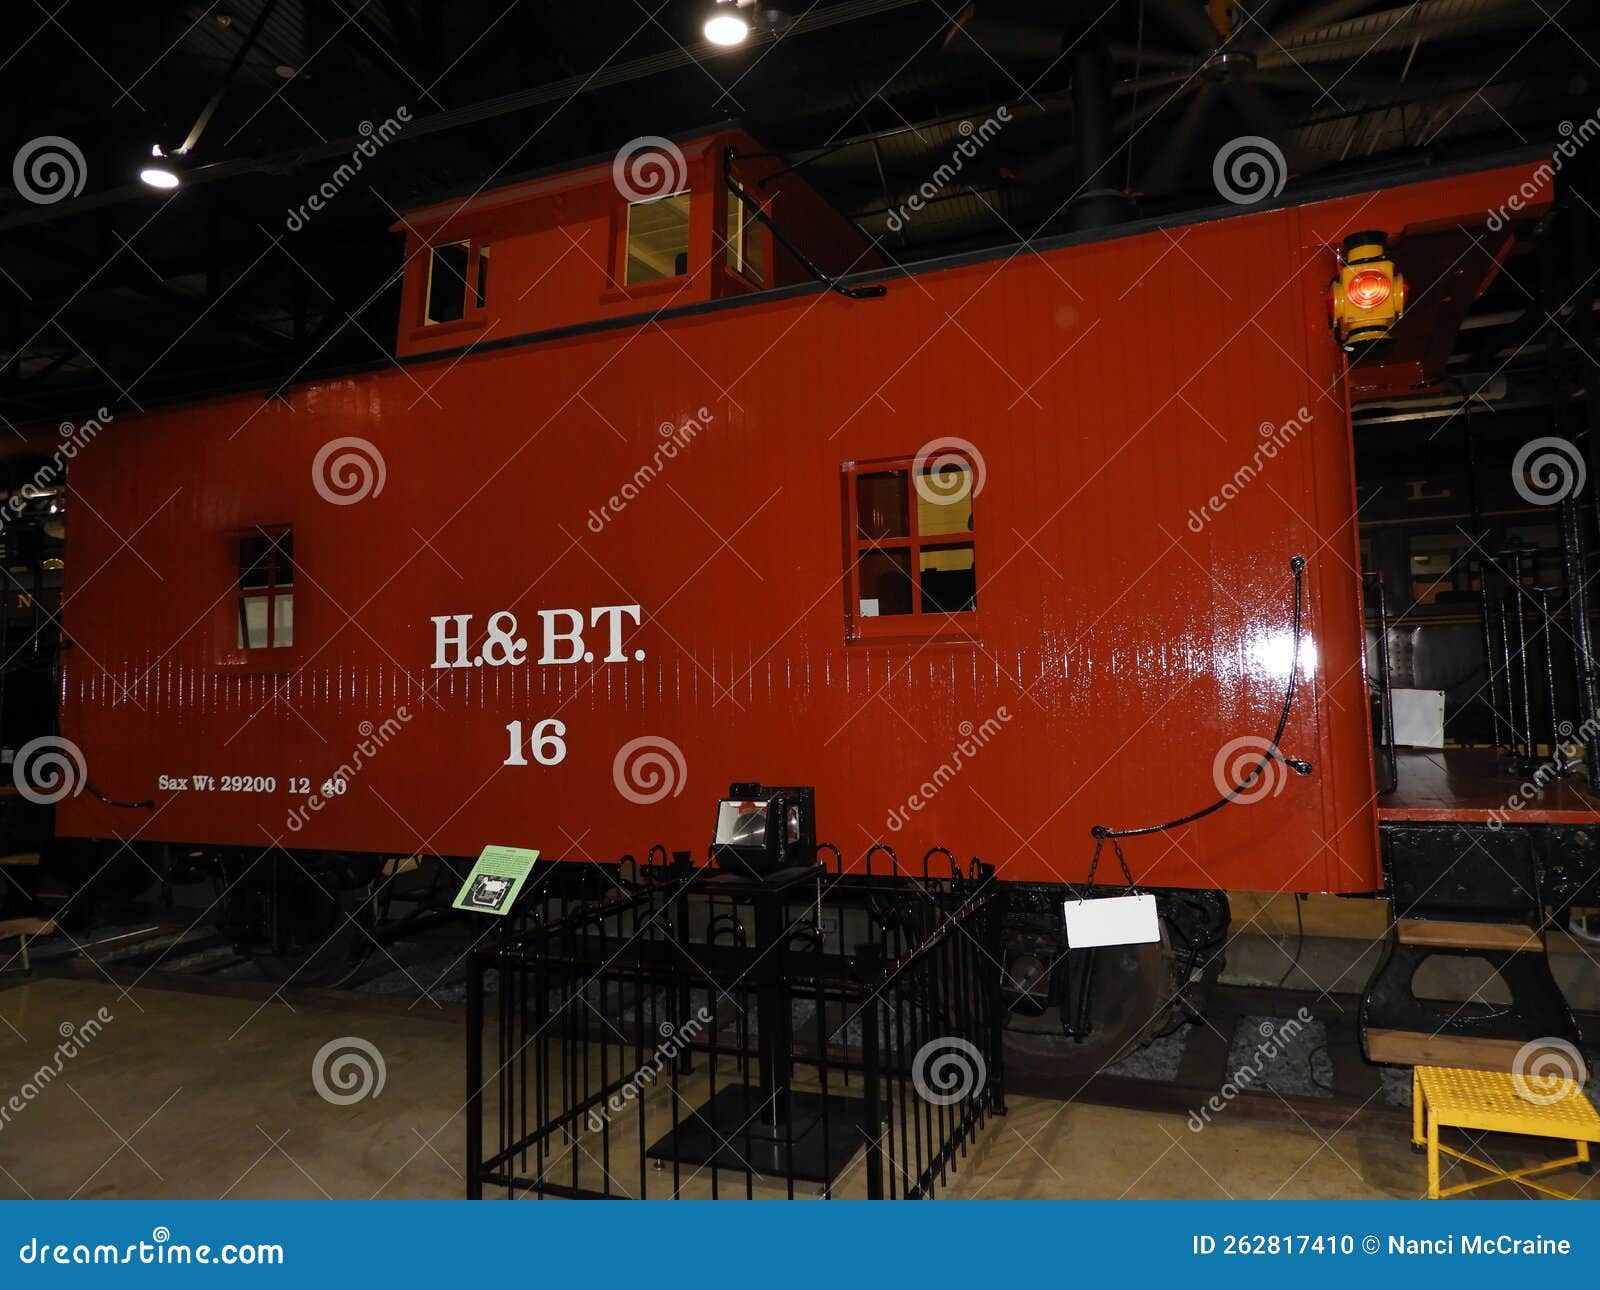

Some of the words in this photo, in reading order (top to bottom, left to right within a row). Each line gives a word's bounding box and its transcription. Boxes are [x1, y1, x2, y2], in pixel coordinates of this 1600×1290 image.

[503, 718, 567, 766] 16
[192, 775, 216, 792] Wt
[220, 775, 276, 793] 29200
[288, 777, 310, 794] 12
